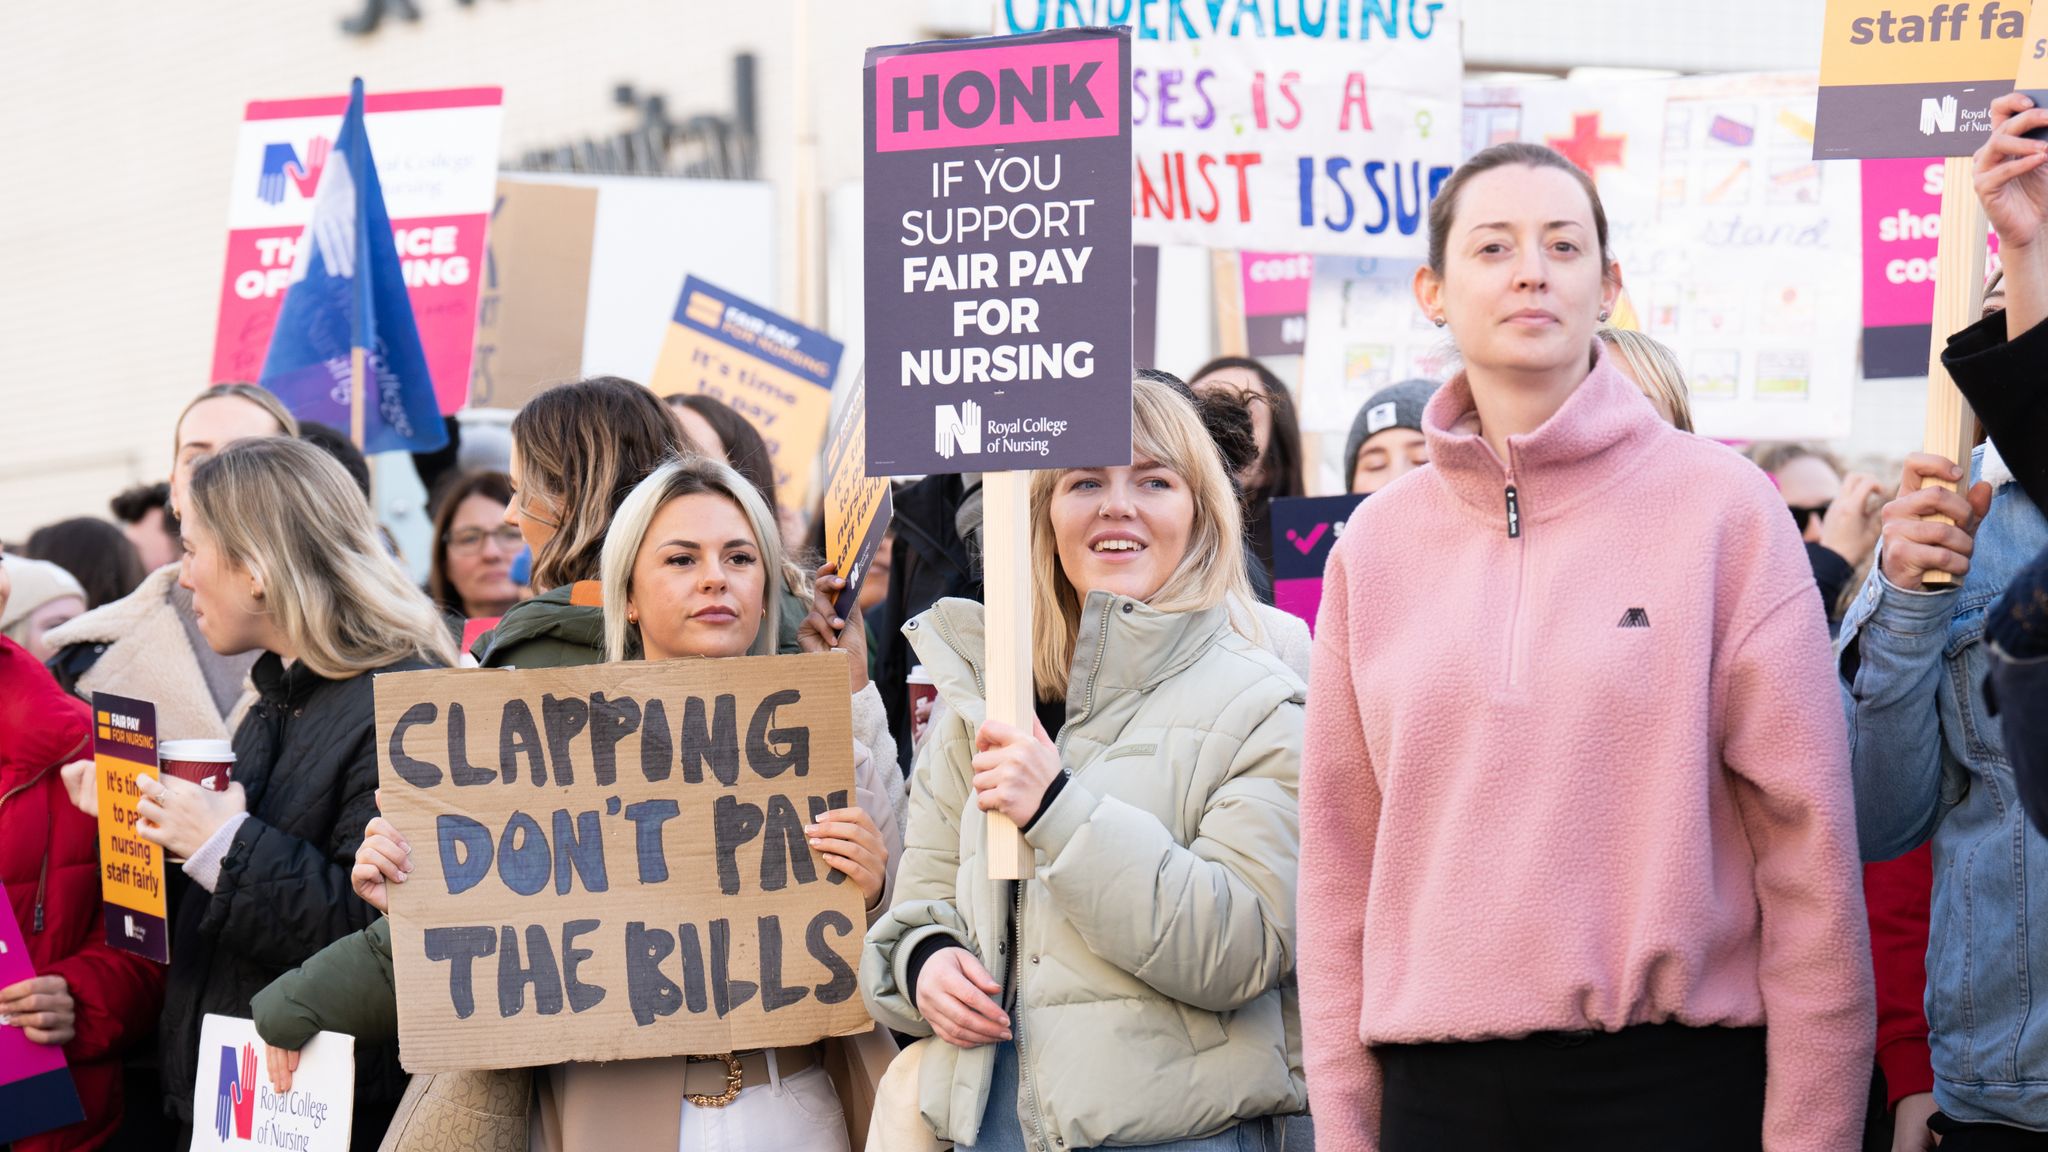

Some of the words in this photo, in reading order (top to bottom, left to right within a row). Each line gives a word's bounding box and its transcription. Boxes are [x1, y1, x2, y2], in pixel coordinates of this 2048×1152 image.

[1850, 3, 1969, 45] staff
[892, 61, 1104, 133] HONK
[1133, 68, 1216, 129] SES
[1252, 71, 1302, 130] IS
[1339, 72, 1373, 131] A
[1961, 108, 1987, 122] Royal
[1960, 121, 1971, 132] of
[1972, 121, 1992, 132] Nurs
[932, 161, 964, 198] IF
[975, 154, 1061, 194] YOU
[1133, 152, 1262, 223] NIST
[901, 199, 1095, 246] SUPPORT
[255, 234, 304, 267] TH
[395, 226, 458, 257] ICE
[903, 253, 999, 293] FAIR
[1010, 246, 1093, 287] PAY
[1885, 256, 1938, 284] cos
[953, 297, 1040, 337] FOR
[901, 341, 1094, 386] NURSING
[987, 418, 1020, 438] Royal
[1023, 418, 1068, 436] College
[987, 439, 1001, 453] of
[1003, 437, 1049, 456] Nursing
[837, 476, 873, 545] nursi
[836, 520, 855, 571] taff
[111, 713, 127, 728] FAIR
[126, 716, 140, 731] PAY
[112, 728, 125, 743] FOR
[125, 731, 154, 750] NURSING
[389, 690, 809, 788] CLAPPING
[107, 770, 122, 793] It's
[125, 773, 143, 798] tim
[113, 803, 124, 823] to
[127, 809, 141, 830] pa
[111, 835, 151, 866] nursing
[437, 796, 681, 896] DON'T
[107, 862, 130, 885] staff
[132, 866, 159, 898] fairly
[424, 918, 606, 1019] THE
[626, 910, 858, 1026] BILLS
[261, 1086, 287, 1120] Royal
[290, 1091, 328, 1129] College
[257, 1120, 270, 1144] of
[271, 1123, 310, 1152] Nursing
